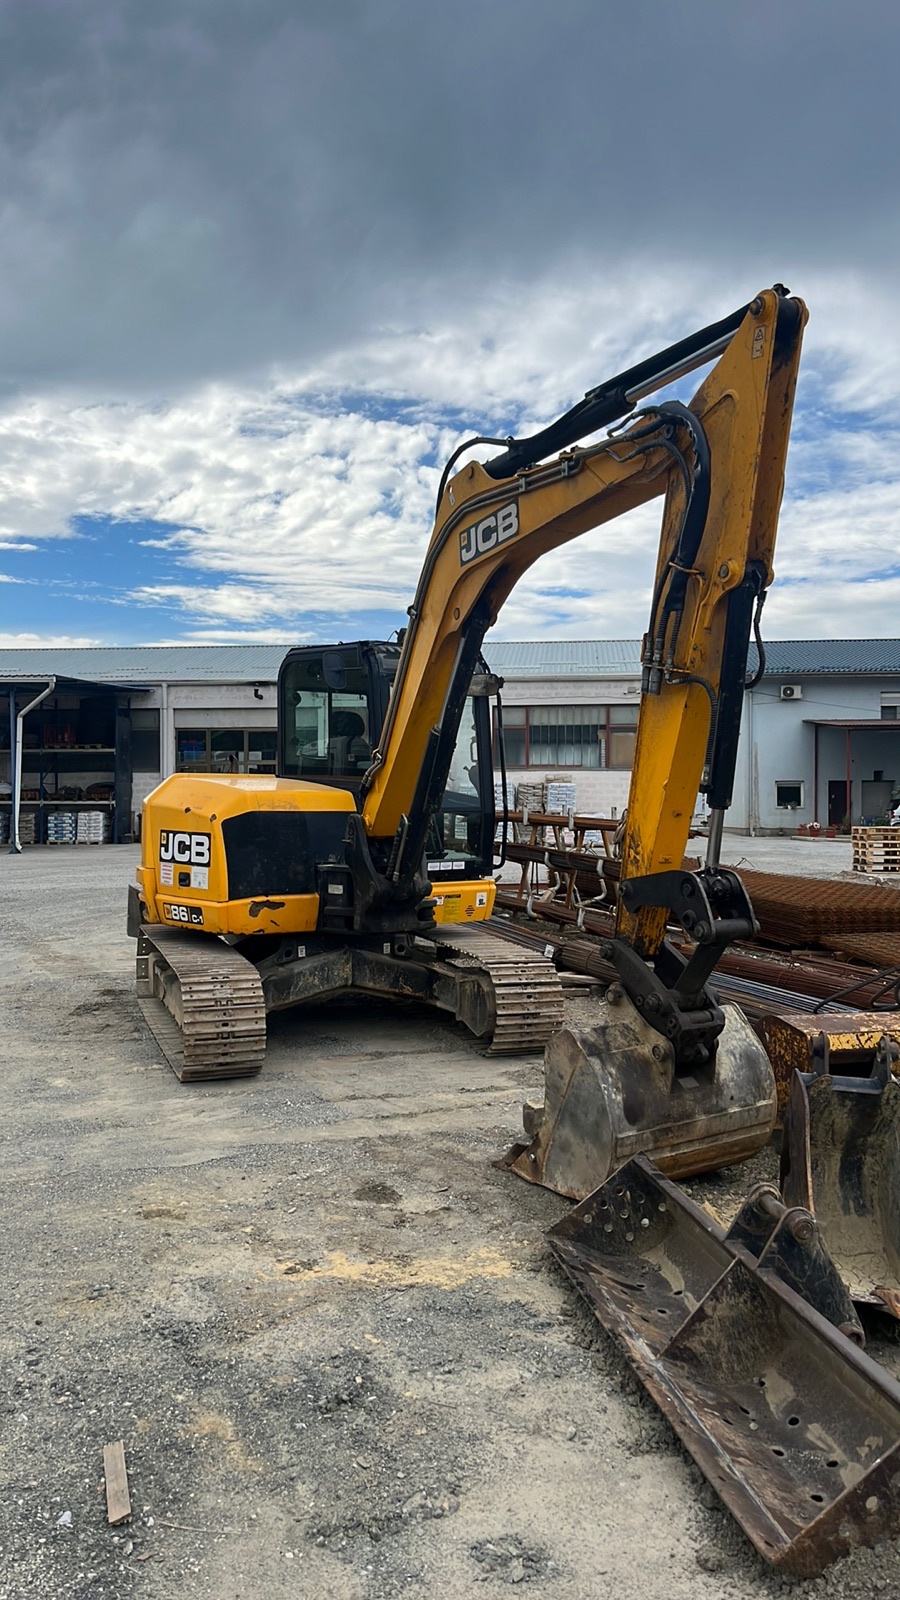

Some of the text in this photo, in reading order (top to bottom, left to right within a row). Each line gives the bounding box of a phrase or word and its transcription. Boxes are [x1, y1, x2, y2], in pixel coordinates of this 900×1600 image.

[461, 503, 518, 562] JCB
[160, 833, 210, 864] JCB
[170, 905, 189, 922] 86
